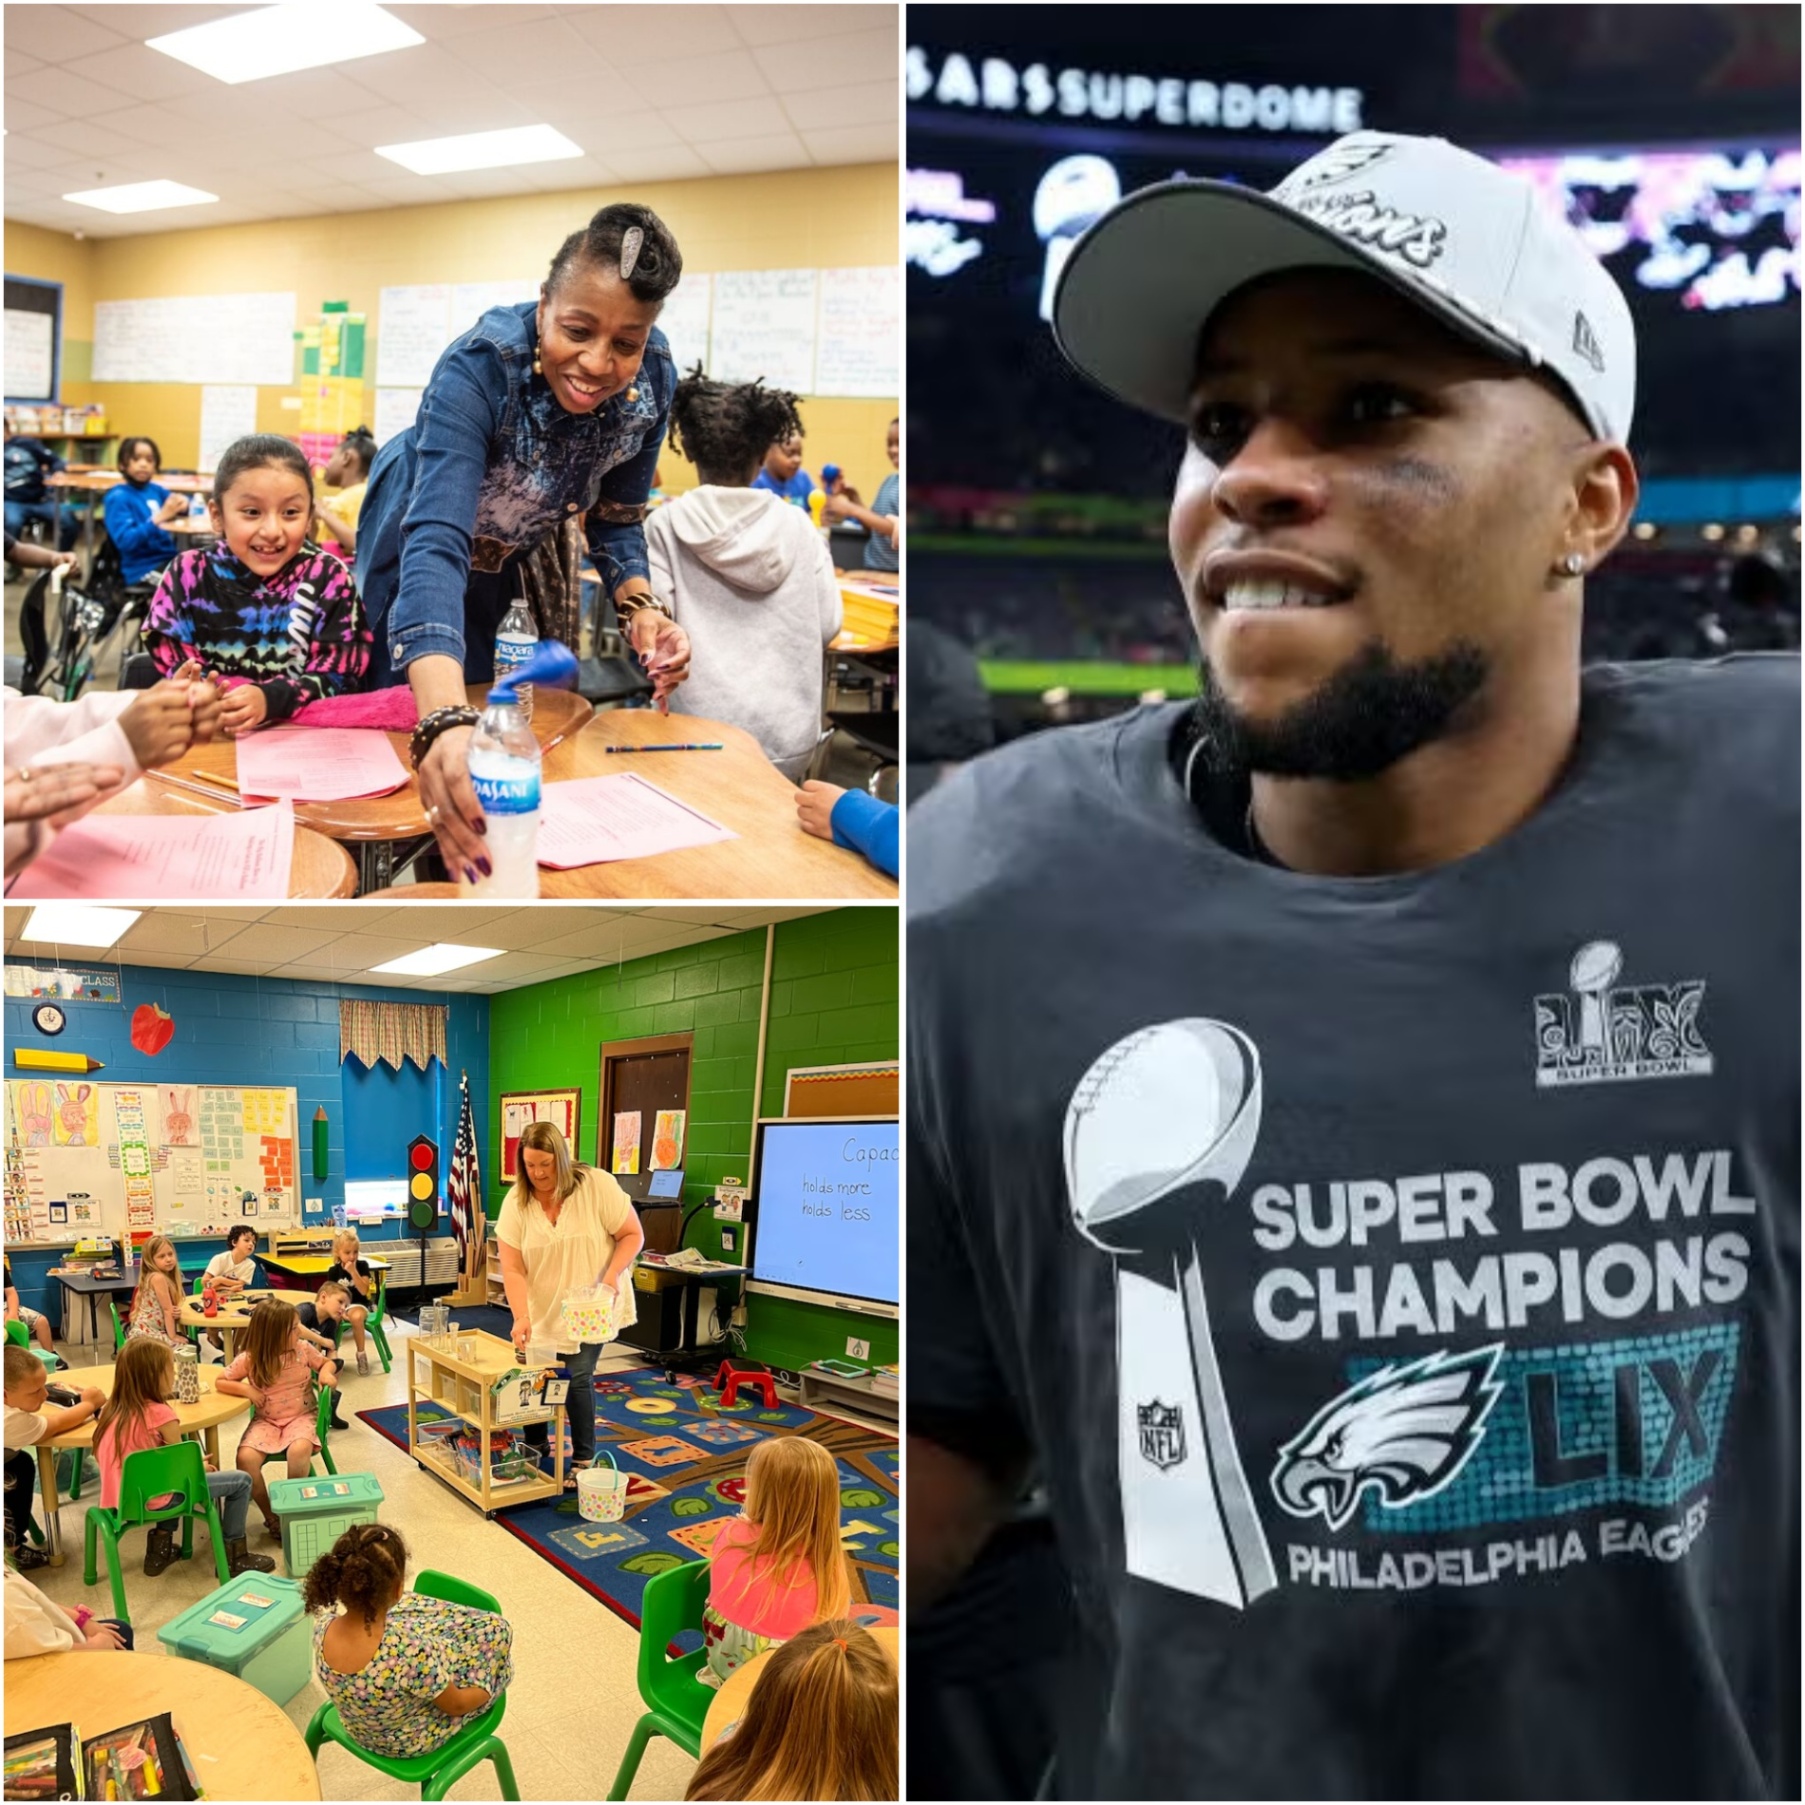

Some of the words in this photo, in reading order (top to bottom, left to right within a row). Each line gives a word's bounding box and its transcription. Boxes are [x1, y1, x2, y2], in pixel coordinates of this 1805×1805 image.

[1056, 68, 1363, 133] SUPERDOME
[80, 975, 116, 987] CLASS
[1556, 1064, 1627, 1081] SUPER
[1635, 1058, 1688, 1075] BOWL
[802, 1172, 834, 1194] holds
[838, 1183, 872, 1195] more
[1251, 1171, 1499, 1250] SUPER
[1518, 1150, 1756, 1231] BOWL
[802, 1199, 832, 1217] holds
[841, 1200, 871, 1221] less
[1253, 1231, 1751, 1341] CHAMPIONS
[1525, 1351, 1723, 1491] LIX
[1141, 1428, 1179, 1462] NFL
[1287, 1530, 1587, 1590] PHILADELPHIA
